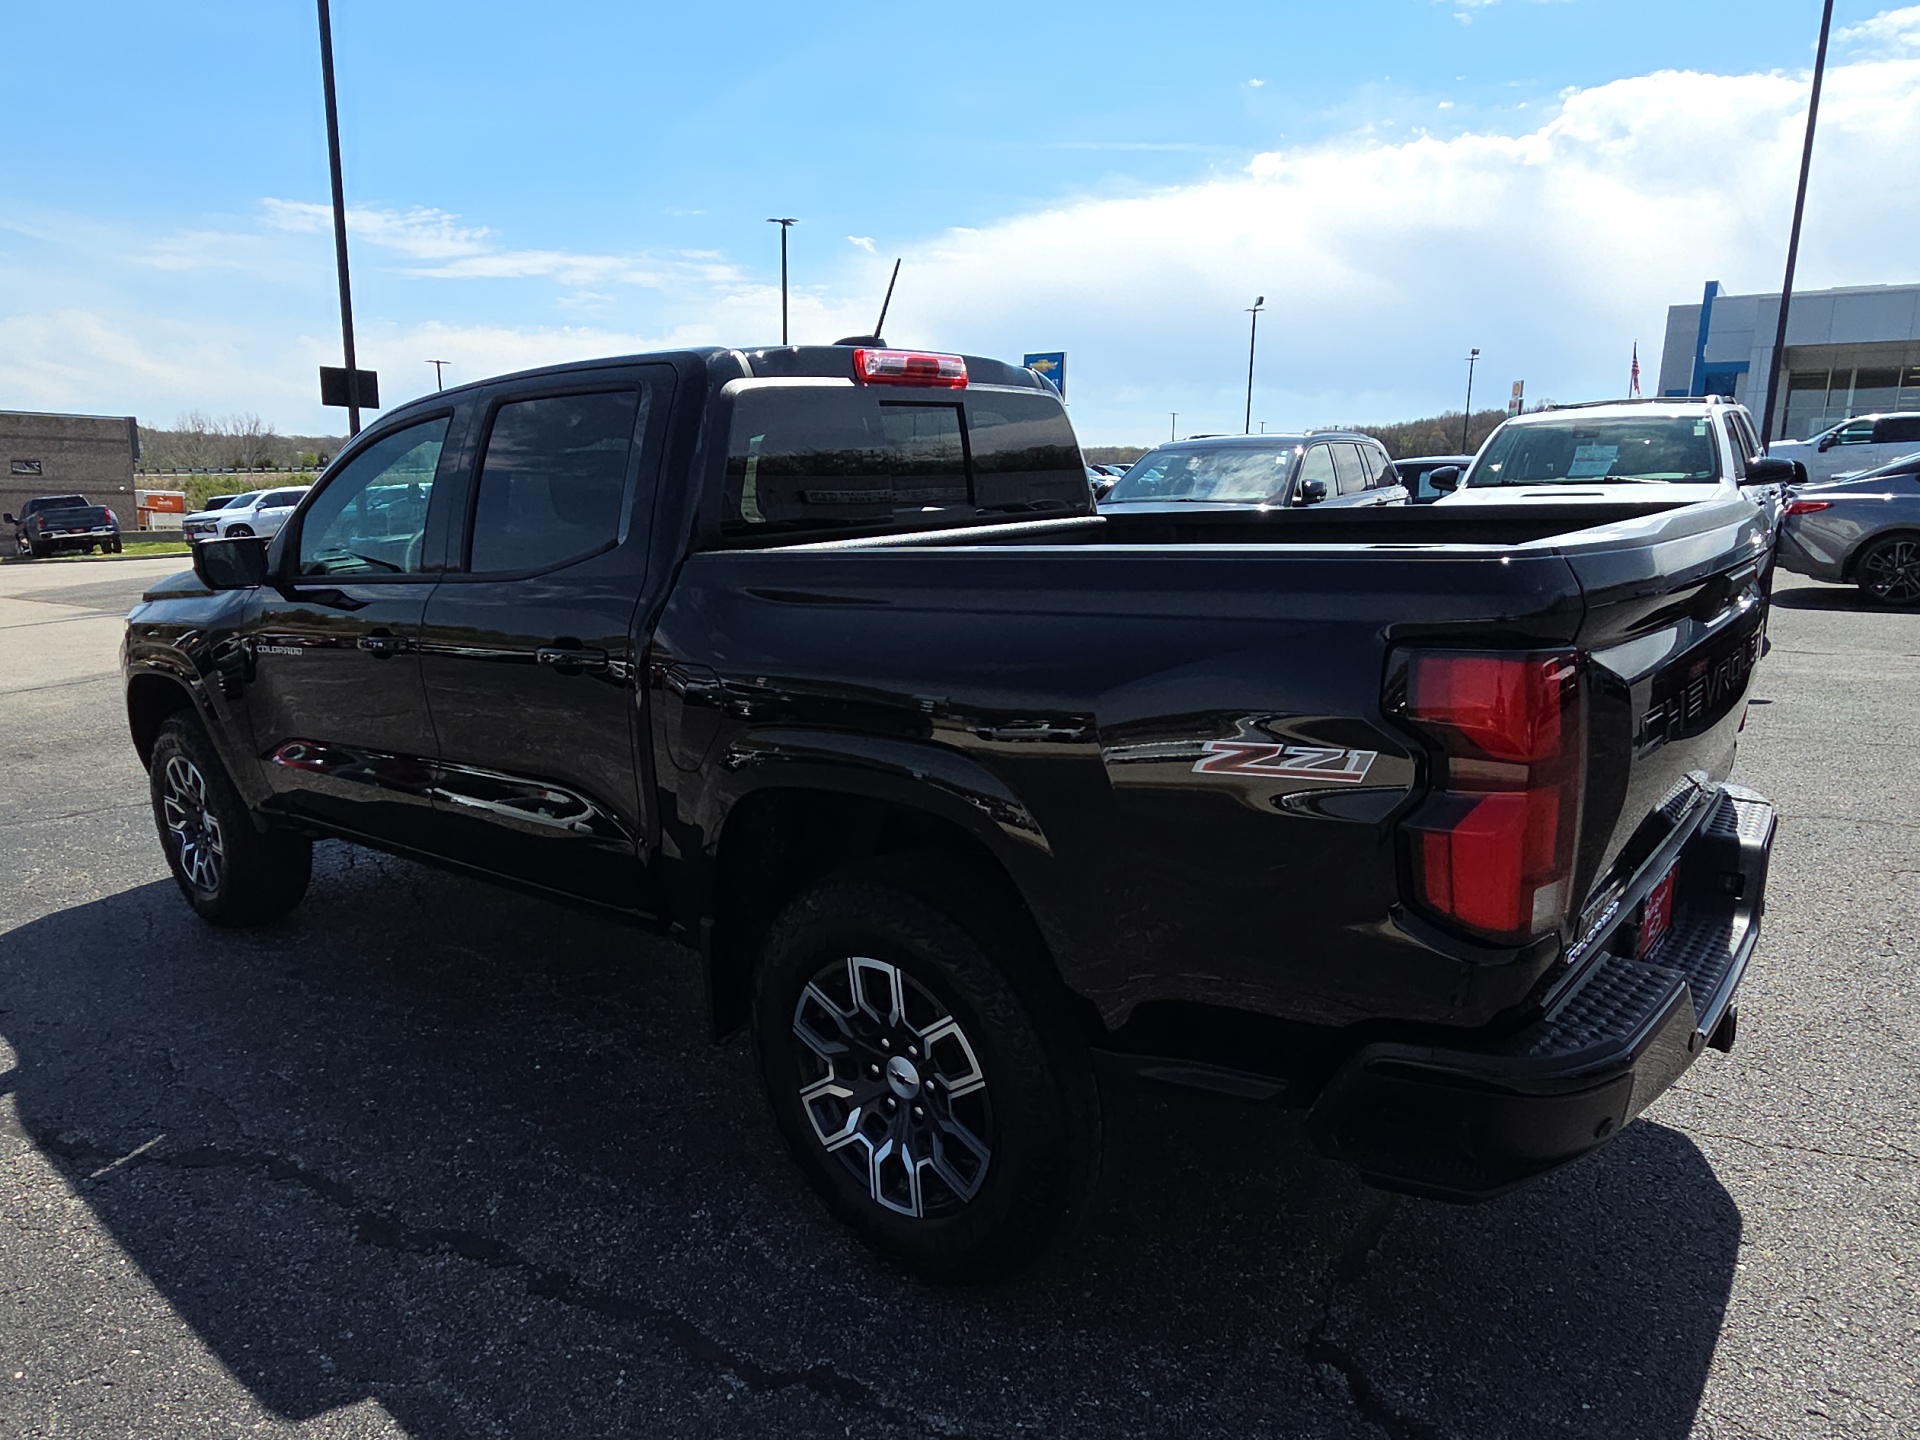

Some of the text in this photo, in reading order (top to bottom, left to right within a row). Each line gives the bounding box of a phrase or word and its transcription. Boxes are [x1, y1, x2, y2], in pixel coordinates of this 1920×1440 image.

[256, 645, 303, 656] COLORADO
[1639, 623, 1763, 757] CHEVROLET
[1191, 740, 1379, 784] Z71
